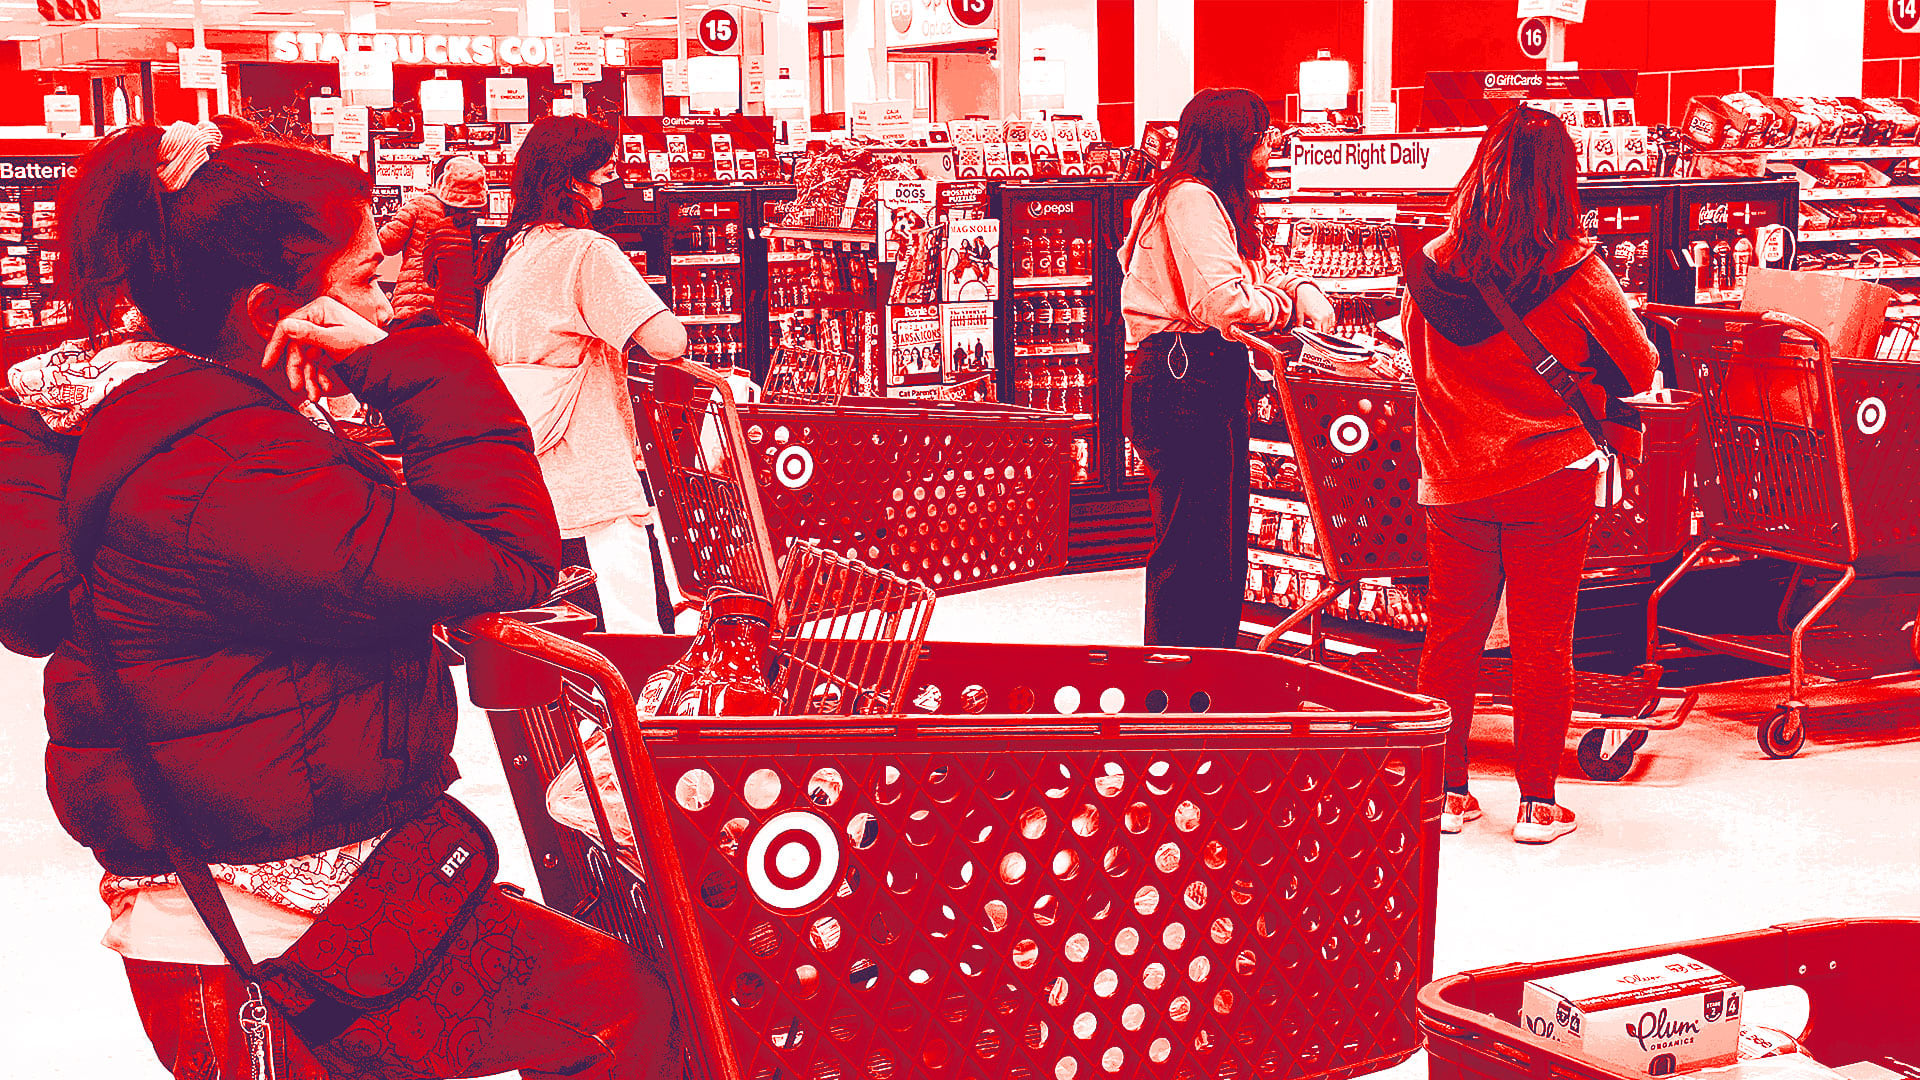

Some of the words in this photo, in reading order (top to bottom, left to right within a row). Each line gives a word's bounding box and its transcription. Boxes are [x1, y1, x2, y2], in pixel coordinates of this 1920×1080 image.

[1897, 0, 1916, 18] 14
[706, 20, 732, 41] 15
[1526, 28, 1542, 46] 16
[500, 36, 626, 66] COE
[1496, 74, 1542, 86] GiftCards
[671, 117, 704, 126] GiftCards
[1294, 144, 1342, 166] Priced
[1346, 143, 1386, 170] Right
[1390, 142, 1430, 170] Daily
[896, 189, 926, 198] DOGS
[942, 188, 983, 198] CROSSWORD
[948, 195, 977, 203] PUZZLES
[1044, 202, 1074, 216] pepsi
[904, 306, 928, 317] People
[440, 846, 470, 878] BT21
[1728, 1000, 1736, 1012] 4
[1637, 1008, 1700, 1051] Plum
[1651, 1038, 1694, 1050] ORGANICS
